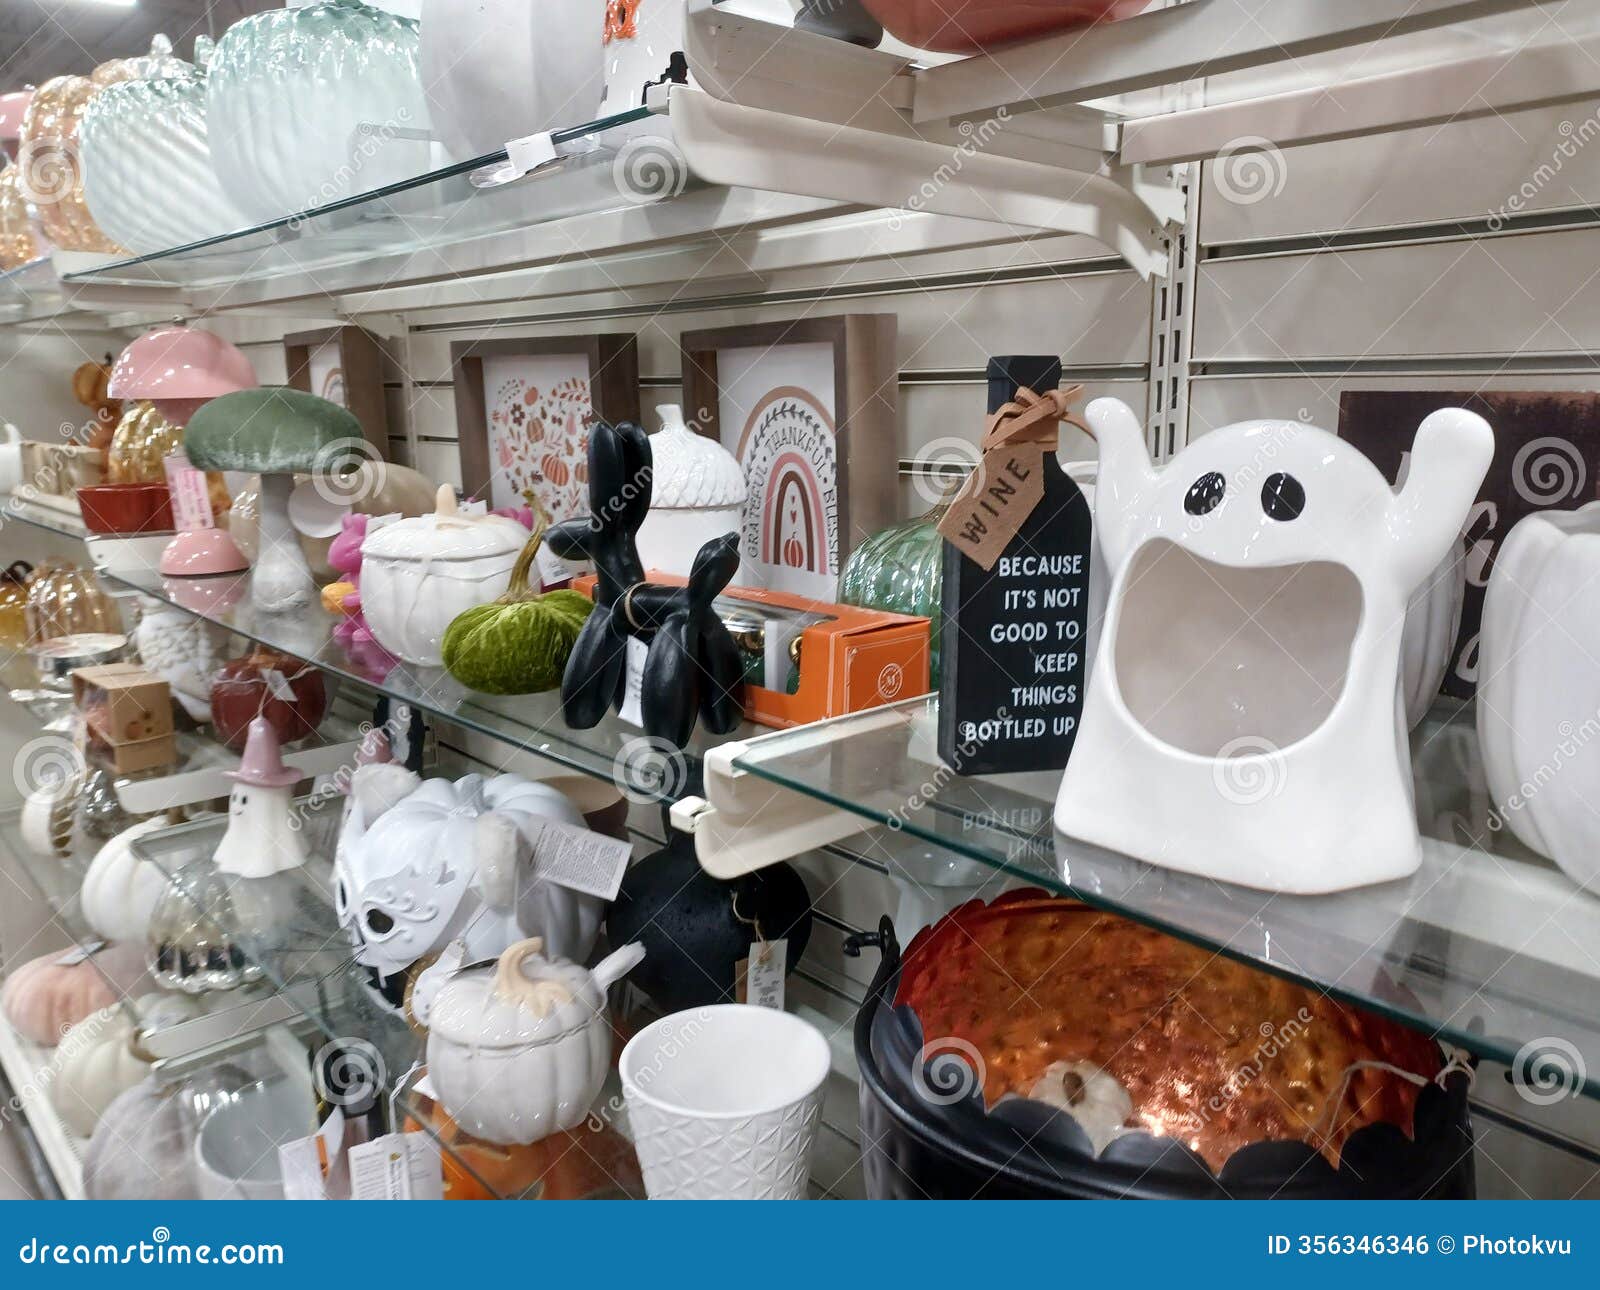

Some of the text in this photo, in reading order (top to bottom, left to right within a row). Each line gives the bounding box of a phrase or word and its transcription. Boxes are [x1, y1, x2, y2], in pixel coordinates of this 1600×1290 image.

[747, 464, 768, 559] GRATEFUL
[764, 426, 827, 479] THANKFUL
[959, 458, 1031, 545] WINE
[999, 554, 1083, 577] BECAUSE
[1004, 588, 1081, 610] IT'S NOT
[990, 620, 1080, 644] GOOD TO
[1034, 652, 1078, 674] KEEP
[1011, 684, 1077, 707] THINGS
[965, 716, 1075, 742] BOTTLED UP
